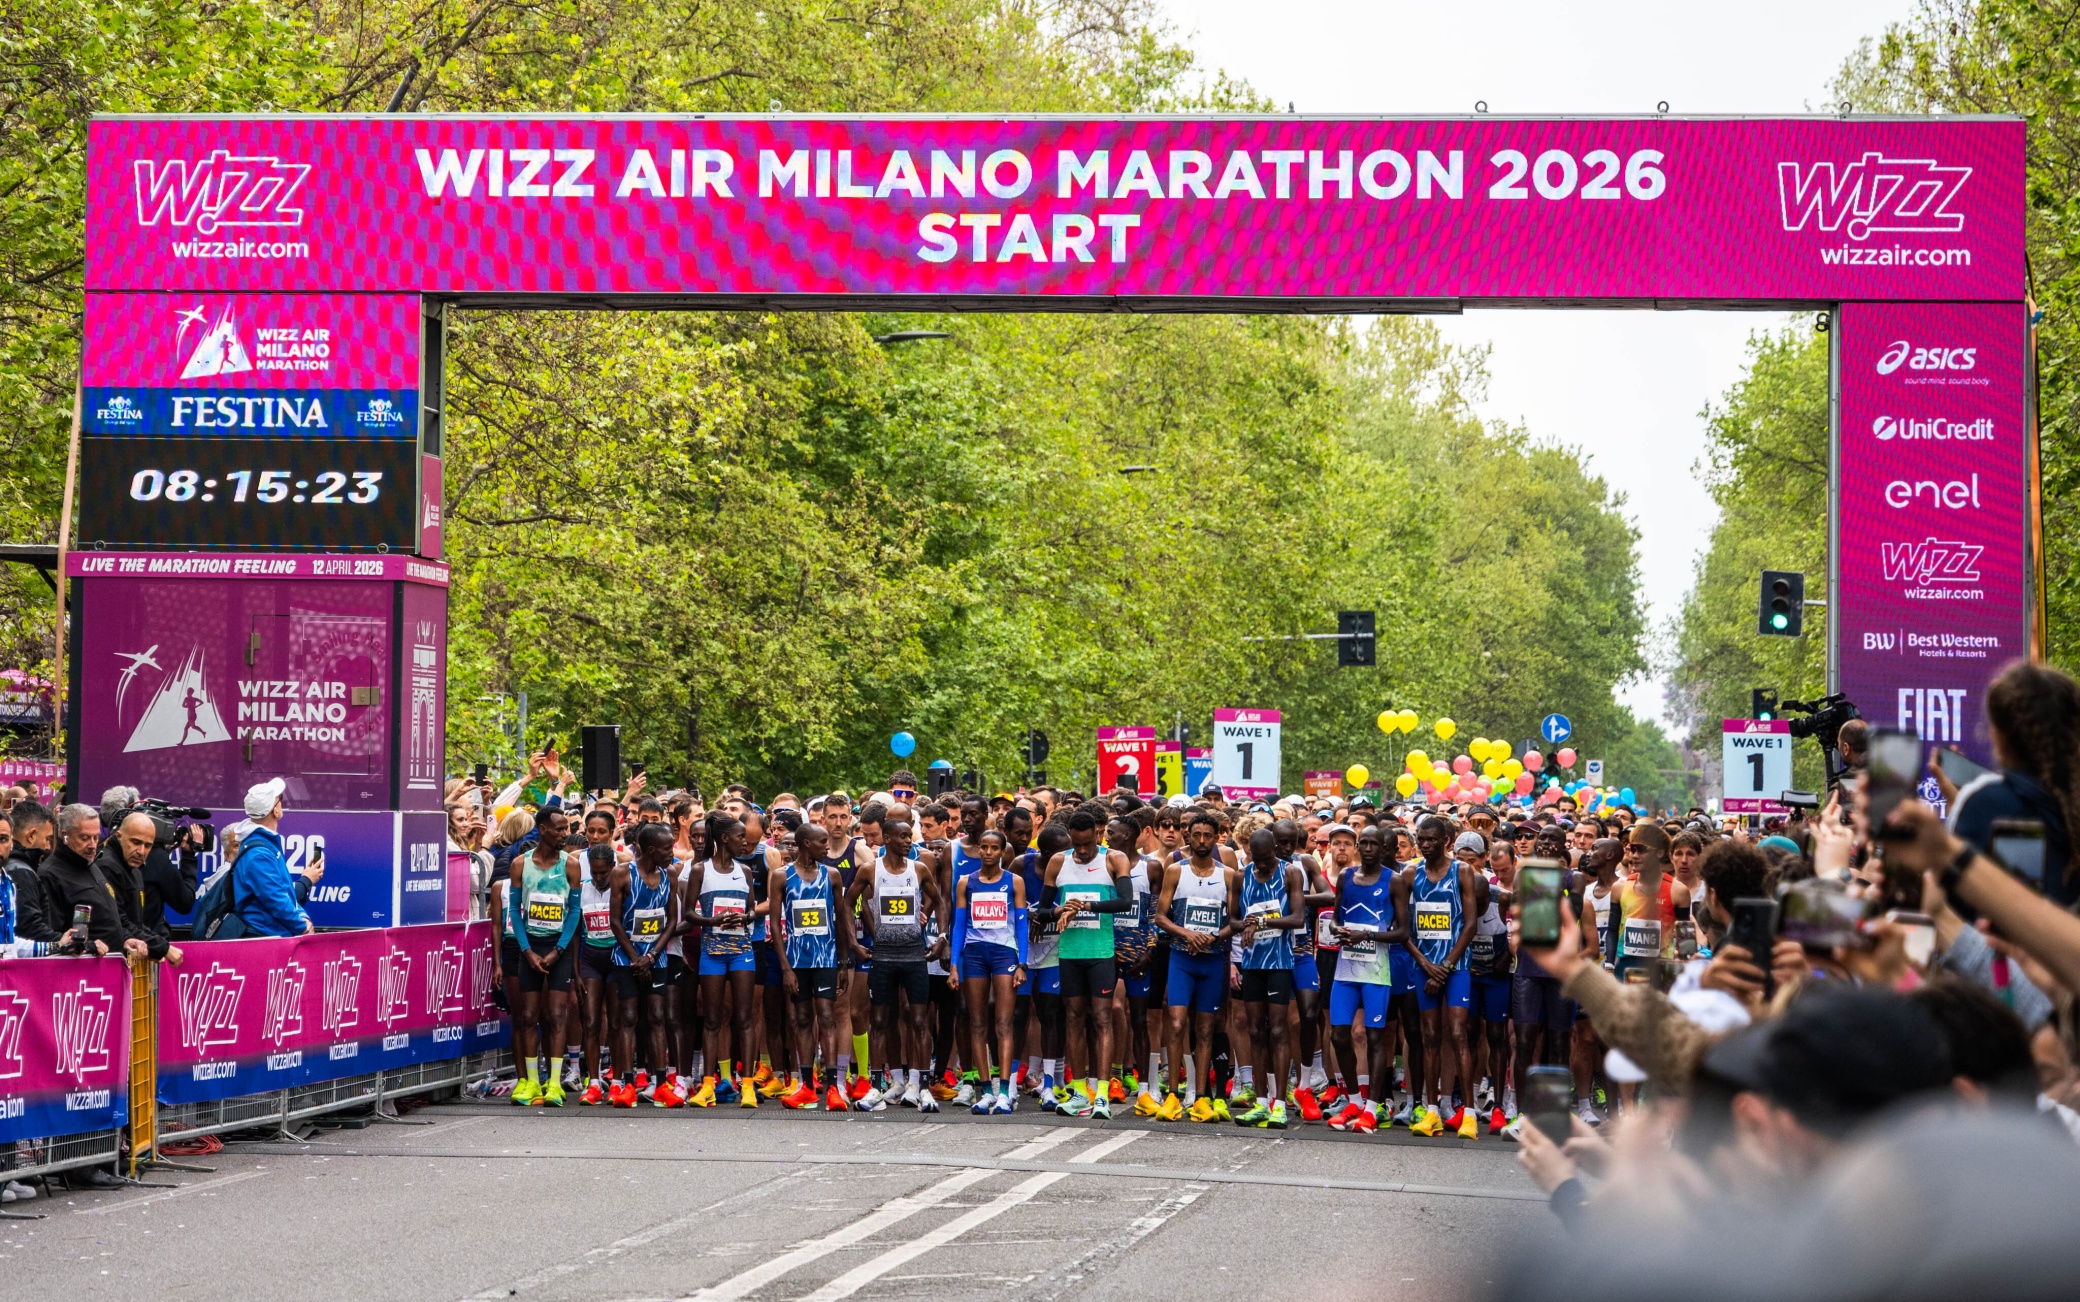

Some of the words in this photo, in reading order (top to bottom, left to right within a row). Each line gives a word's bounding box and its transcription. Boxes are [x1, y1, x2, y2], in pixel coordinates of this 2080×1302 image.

[415, 148, 595, 198] WIZZ
[616, 149, 735, 198] AIR
[758, 148, 1033, 199] MILANO
[1057, 149, 1465, 200] MARATHON
[1489, 148, 1667, 200] 2026
[916, 212, 1141, 264] START
[171, 236, 309, 261] wizzair.com
[1820, 243, 1971, 266] wizzair.com
[256, 328, 298, 341] WIZZ
[302, 329, 330, 341] AIR
[256, 343, 330, 358] MILANO
[256, 360, 329, 371] MARATHON
[97, 409, 143, 420] FESTINA
[170, 396, 328, 428] FESTINA
[357, 411, 404, 422] FESTINA
[1899, 417, 1994, 441] UniCredit
[129, 469, 383, 504] 08:15:23
[1885, 472, 1981, 509] enel
[81, 557, 114, 572] LIVE
[118, 558, 146, 573] THE
[148, 559, 233, 574] MARATHON
[233, 559, 297, 575] FEELING
[312, 560, 325, 575] 12
[325, 560, 354, 575] APRIL
[354, 560, 384, 576] 2026
[1904, 586, 1984, 600] wizzair.com
[1863, 632, 1895, 650] BW
[1908, 633, 1939, 647] Best
[1919, 649, 1946, 657] Hotels
[1955, 650, 1986, 658] Resorts
[237, 680, 299, 699] WIZZ
[306, 681, 346, 699] AIR
[237, 702, 347, 723] MILANO
[1898, 688, 1967, 742] FIAT
[237, 726, 345, 742] MARATHON
[1223, 726, 1262, 738] WAVE
[1266, 728, 1271, 738] 1
[1103, 742, 1140, 753] WAVE
[1141, 742, 1148, 752] 1
[1732, 737, 1773, 749] WAVE
[1777, 738, 1783, 749] 1
[1236, 742, 1253, 780] 1
[1746, 752, 1764, 792] 1
[1309, 780, 1332, 788] WAVE
[530, 903, 562, 920] PACER
[888, 899, 908, 915] 39
[974, 904, 1004, 919] KALAYU
[801, 911, 820, 926] 33
[1190, 908, 1216, 924] AYELE
[1418, 914, 1450, 929] PACER
[641, 919, 659, 934] 34
[1628, 931, 1656, 945] WANG
[193, 1057, 237, 1082] wizzair.com
